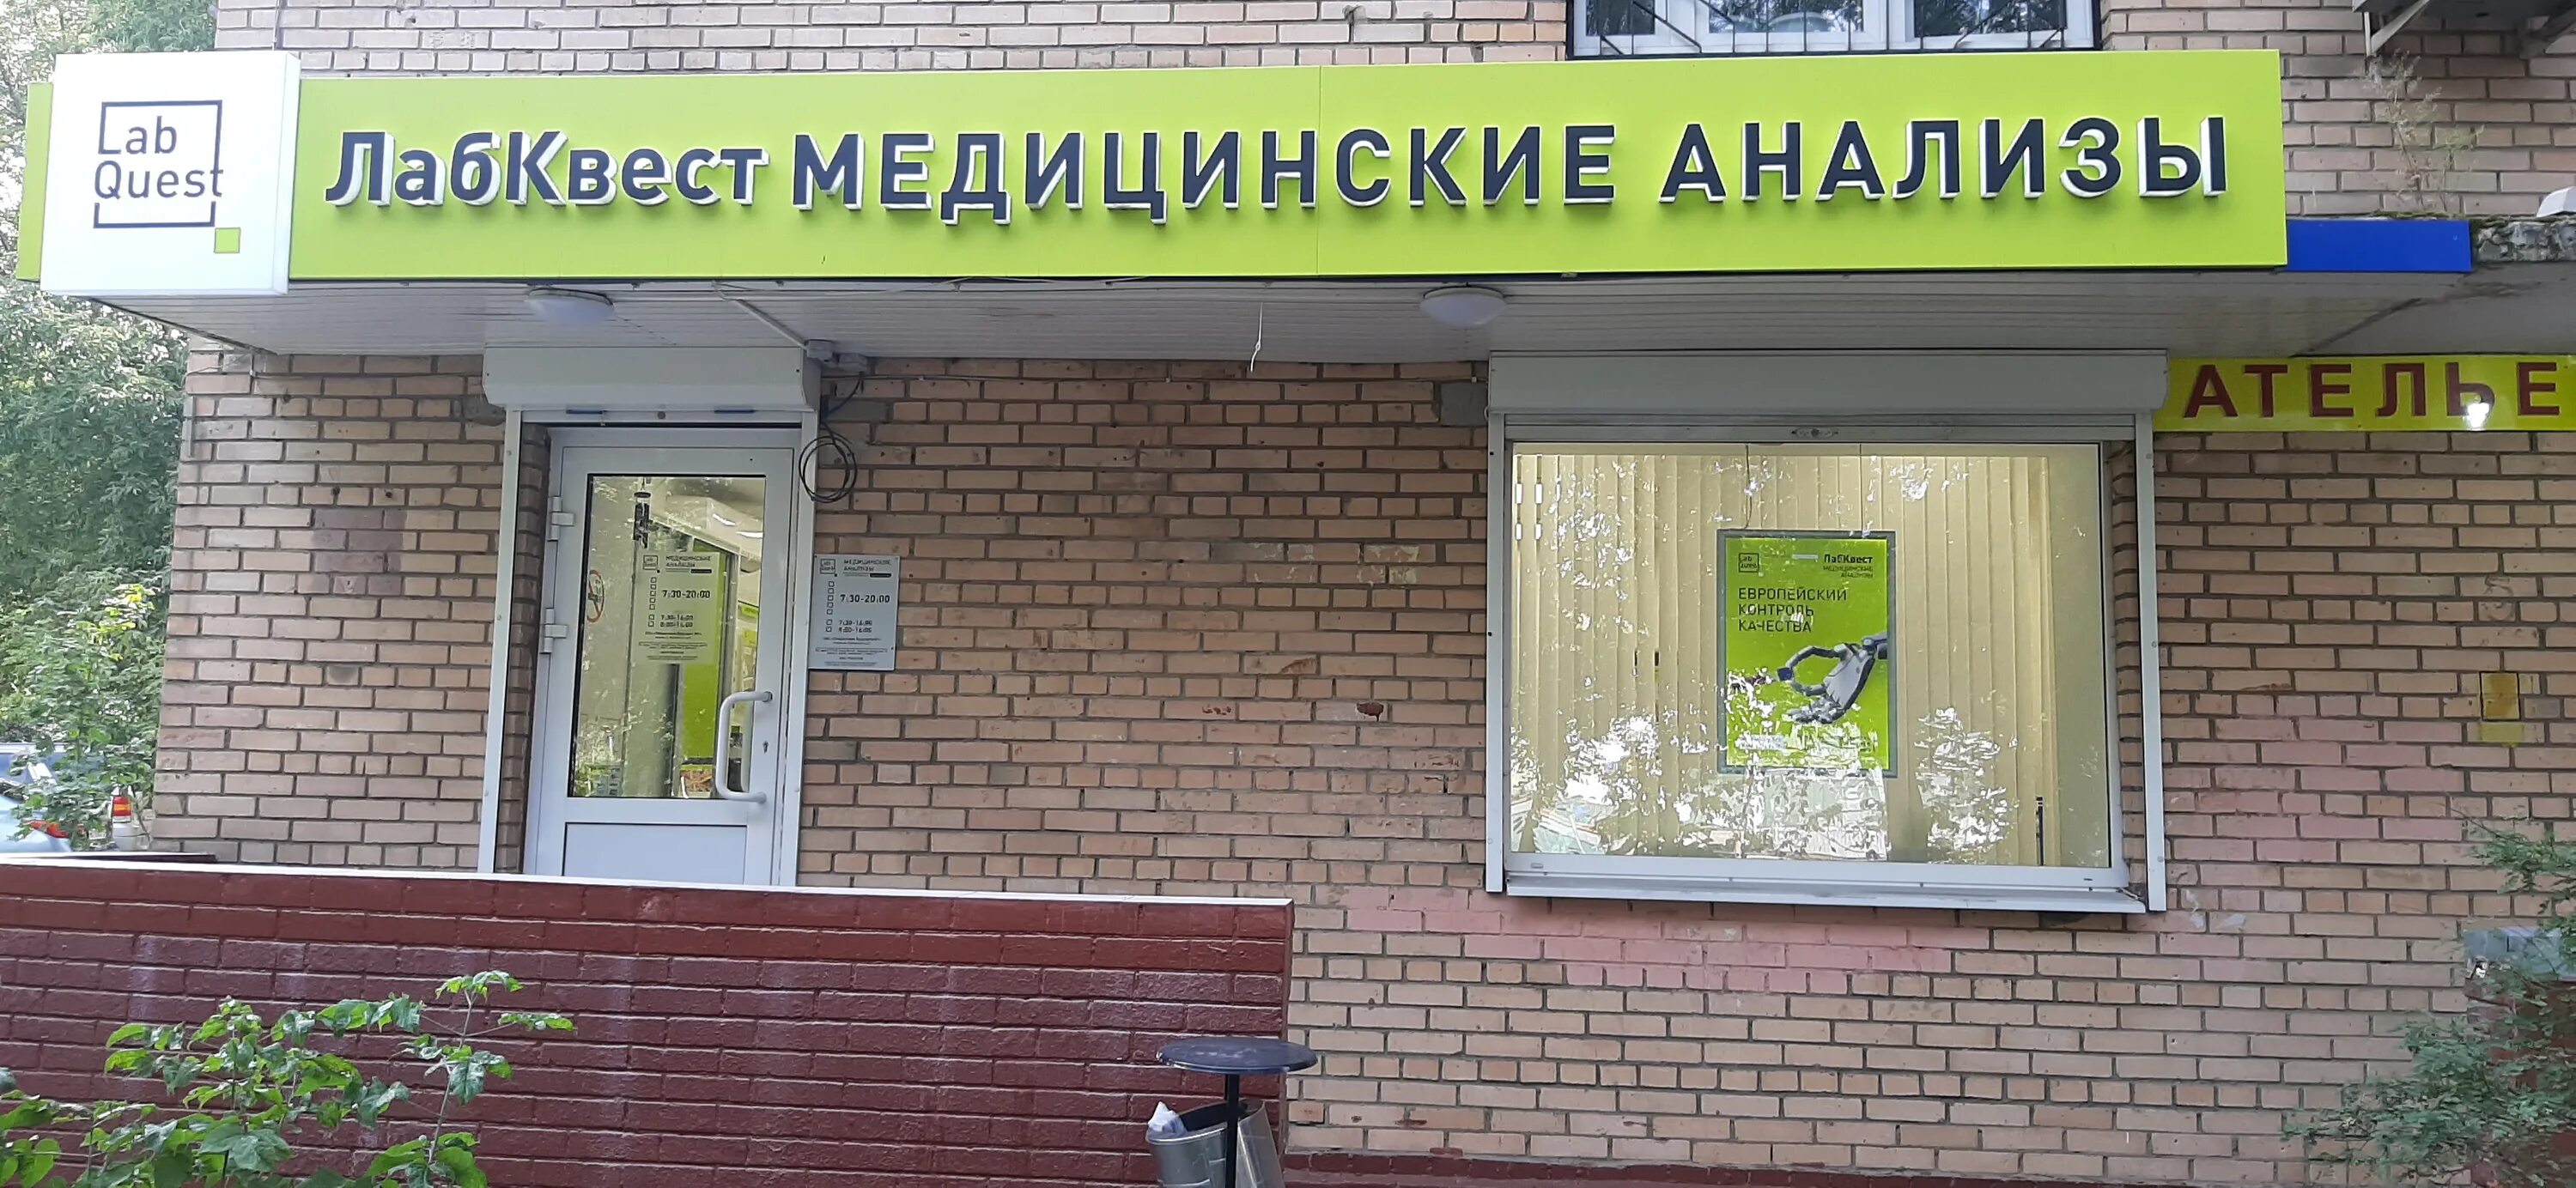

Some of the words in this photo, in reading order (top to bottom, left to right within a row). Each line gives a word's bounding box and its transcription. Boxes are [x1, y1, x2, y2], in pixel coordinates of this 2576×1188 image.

[98, 115, 178, 155] Lab
[325, 130, 769, 209] ЛабКвест
[792, 124, 1615, 226] МЕДИЦИНСКИЕ
[1658, 115, 2227, 205] АНАЛИЗЫ
[93, 160, 224, 201] Quest
[2183, 361, 2561, 419] АТЕЛЬЕ
[662, 590, 710, 598] 7:30-20:00
[840, 594, 890, 603] 7:30-20:00
[1738, 587, 1847, 601] ЕВРОПЕЙСКИЙ
[1738, 603, 1814, 617] КОНТРОЛЬ
[1738, 619, 1812, 633] КАЧЕСТВА
